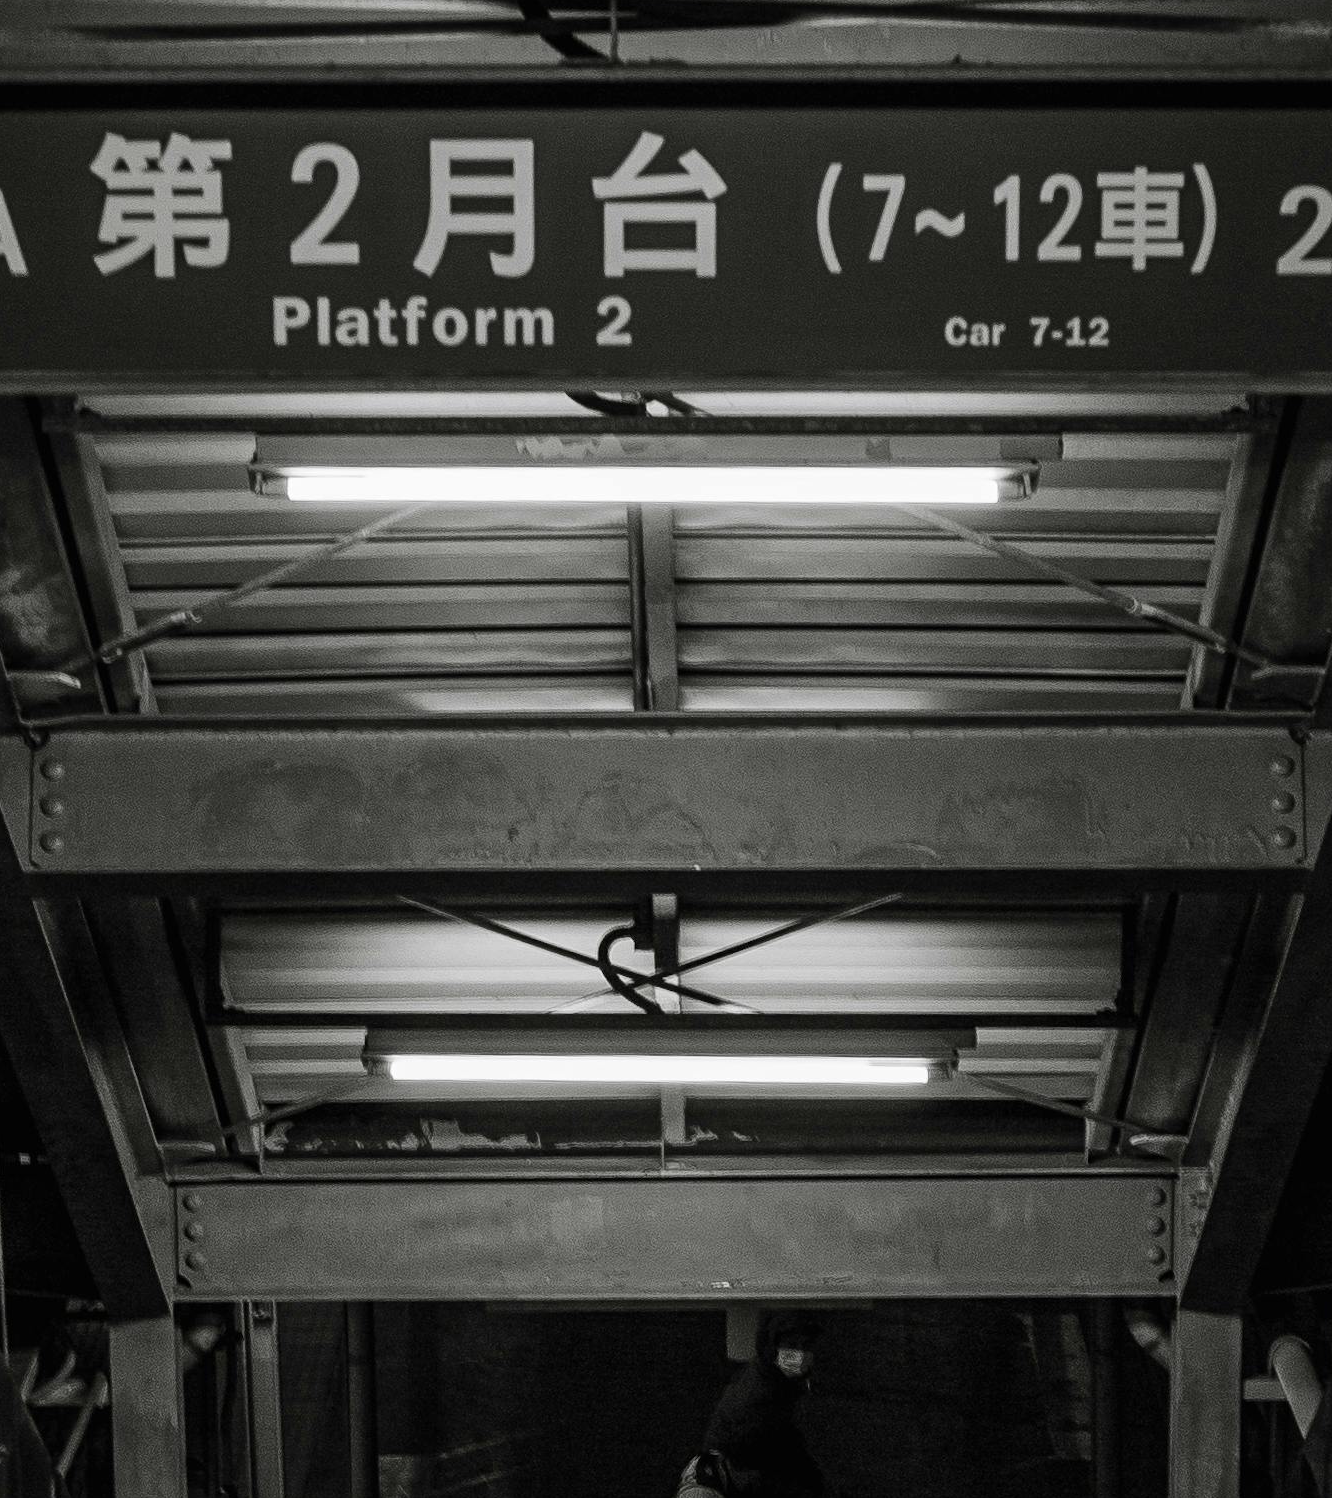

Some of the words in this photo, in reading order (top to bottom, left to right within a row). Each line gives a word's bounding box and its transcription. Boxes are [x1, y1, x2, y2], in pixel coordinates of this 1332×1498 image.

[271, 295, 556, 347] Platform
[595, 295, 634, 347] 2
[944, 315, 1007, 347] Car
[1029, 316, 1110, 348] 7-12
